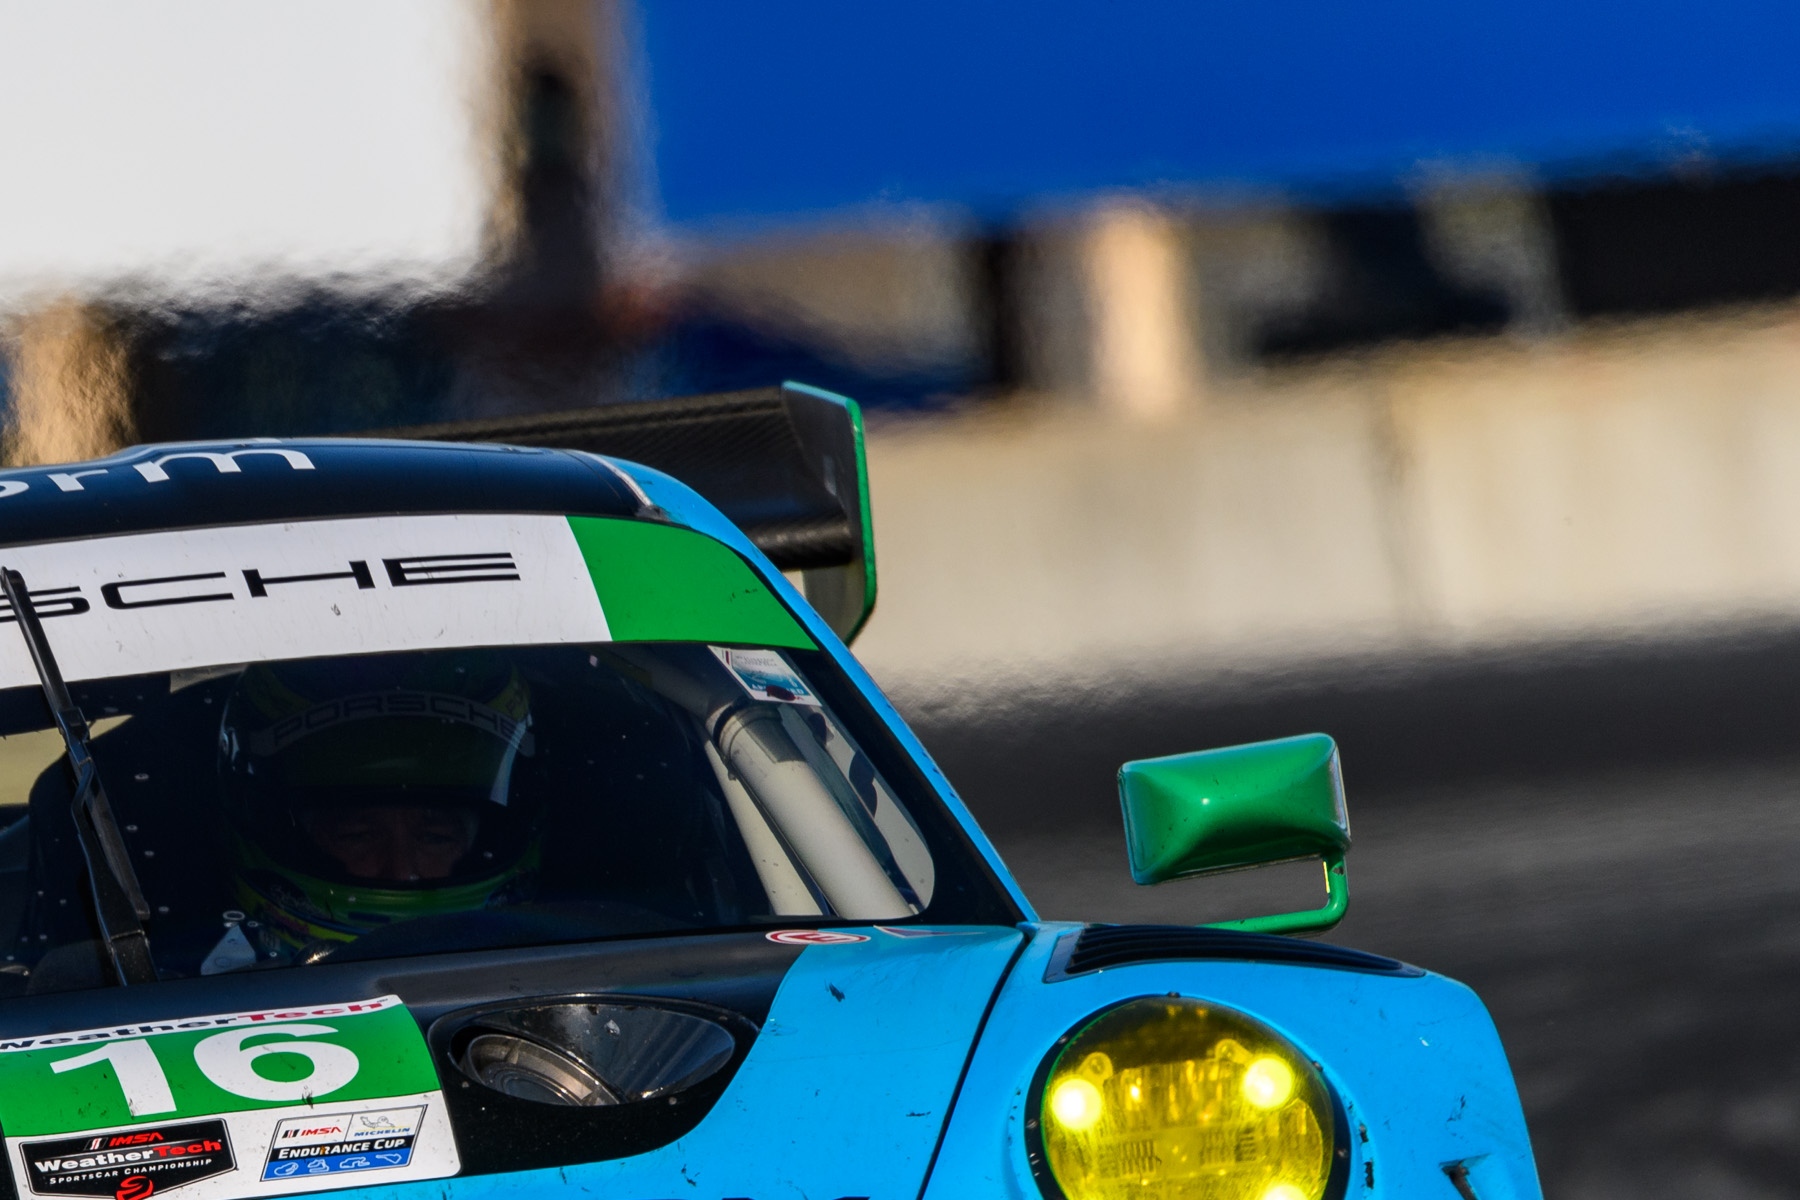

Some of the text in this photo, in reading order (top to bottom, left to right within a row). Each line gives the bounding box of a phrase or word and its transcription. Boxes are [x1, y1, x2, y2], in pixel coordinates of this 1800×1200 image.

[49, 1023, 360, 1117] 16
[108, 1131, 164, 1147] IMSA
[300, 1126, 343, 1137] IMSA
[353, 1127, 411, 1137] MICHELIN
[34, 1139, 222, 1173] WeatherTech
[277, 1138, 406, 1160] ENDURANCE CUP
[123, 1158, 213, 1175] CHAMPIONSHIP
